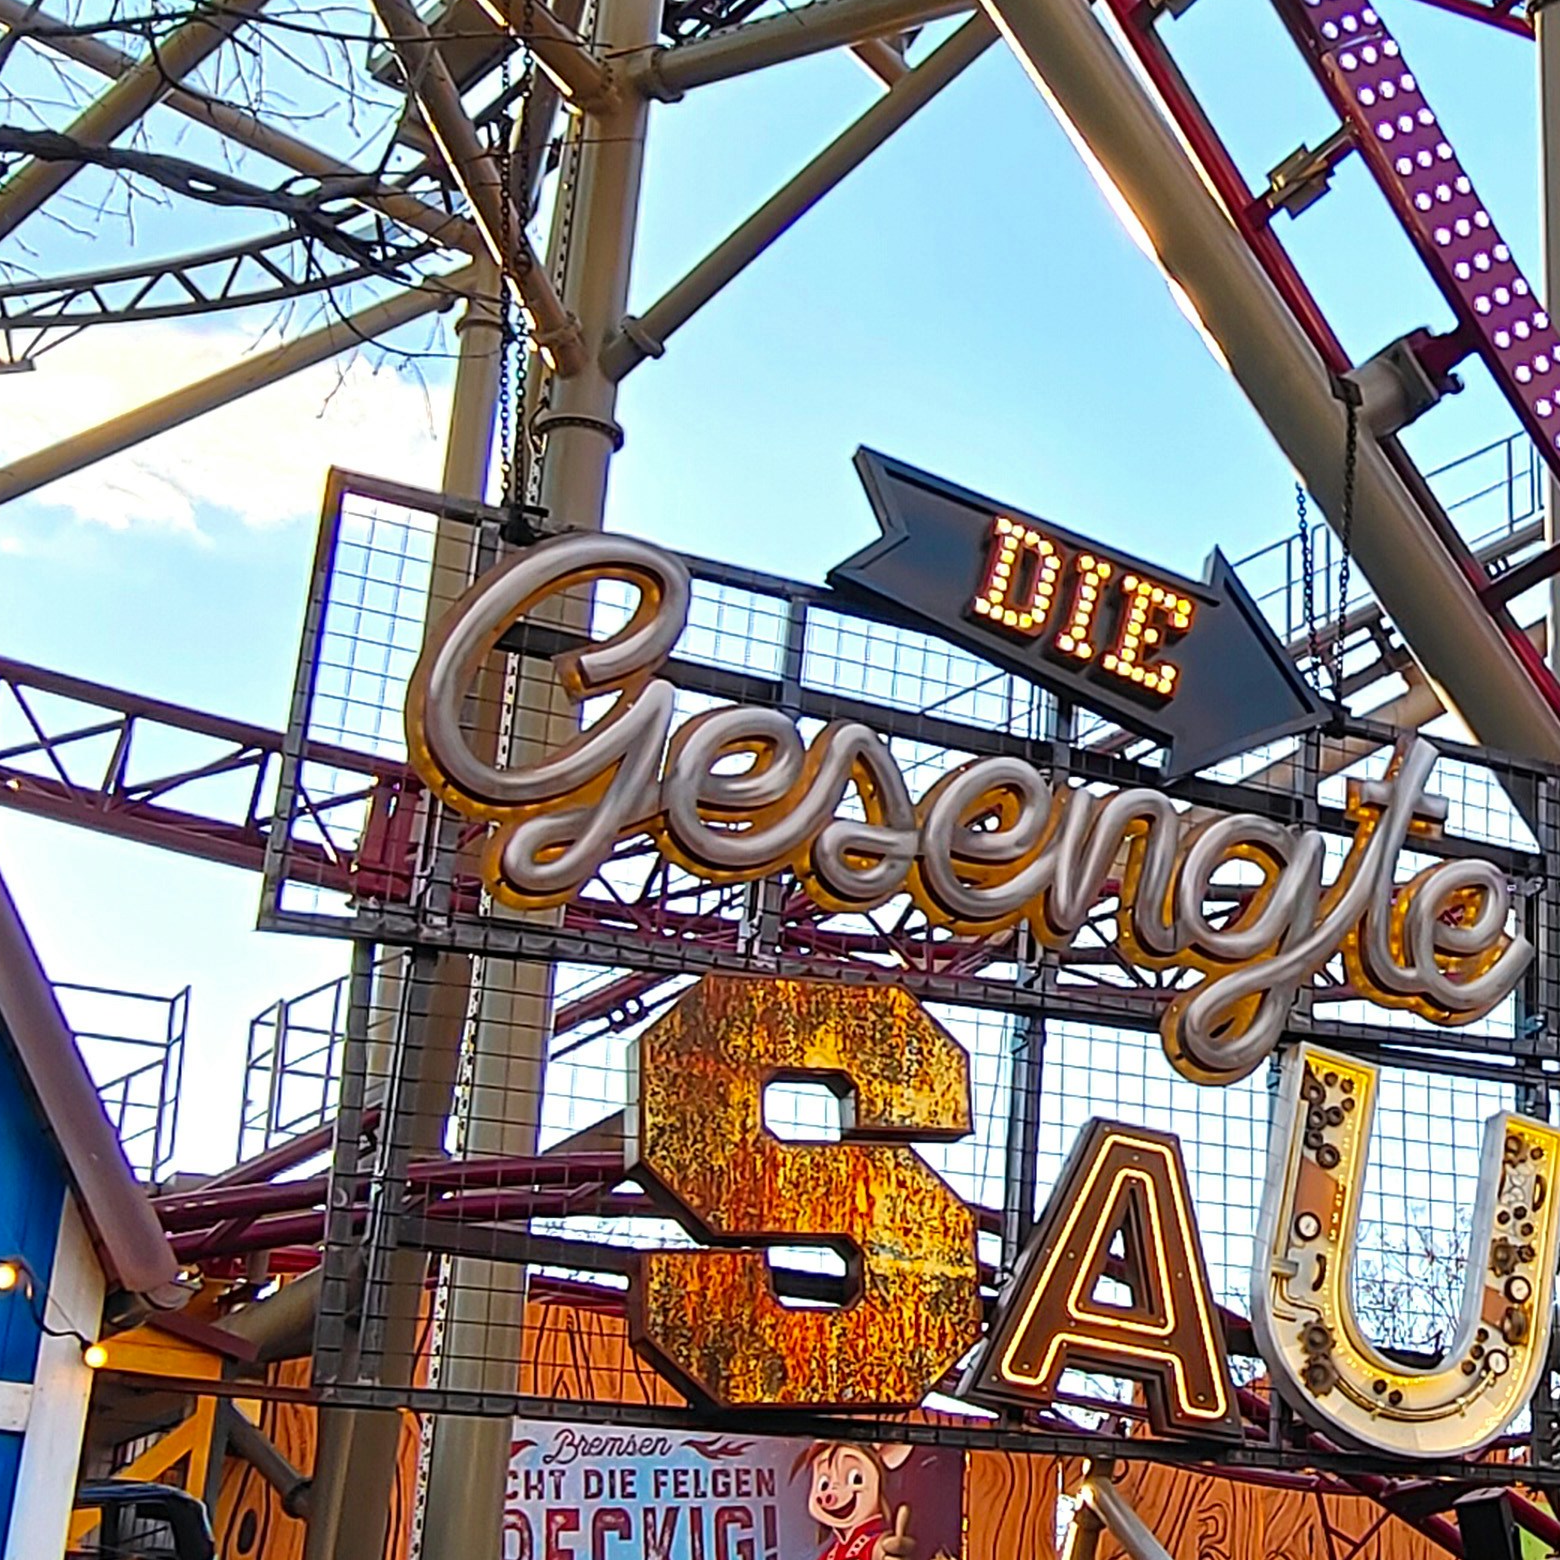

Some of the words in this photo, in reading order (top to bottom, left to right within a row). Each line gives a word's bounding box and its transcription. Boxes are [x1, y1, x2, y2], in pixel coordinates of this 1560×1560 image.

[970, 514, 1197, 696] DIE
[405, 532, 1535, 1087] Gesengte
[505, 1469, 566, 1500] CHT
[584, 1468, 637, 1500] DIE
[653, 1468, 777, 1499] FELGEN
[543, 1428, 672, 1465] Bremsen
